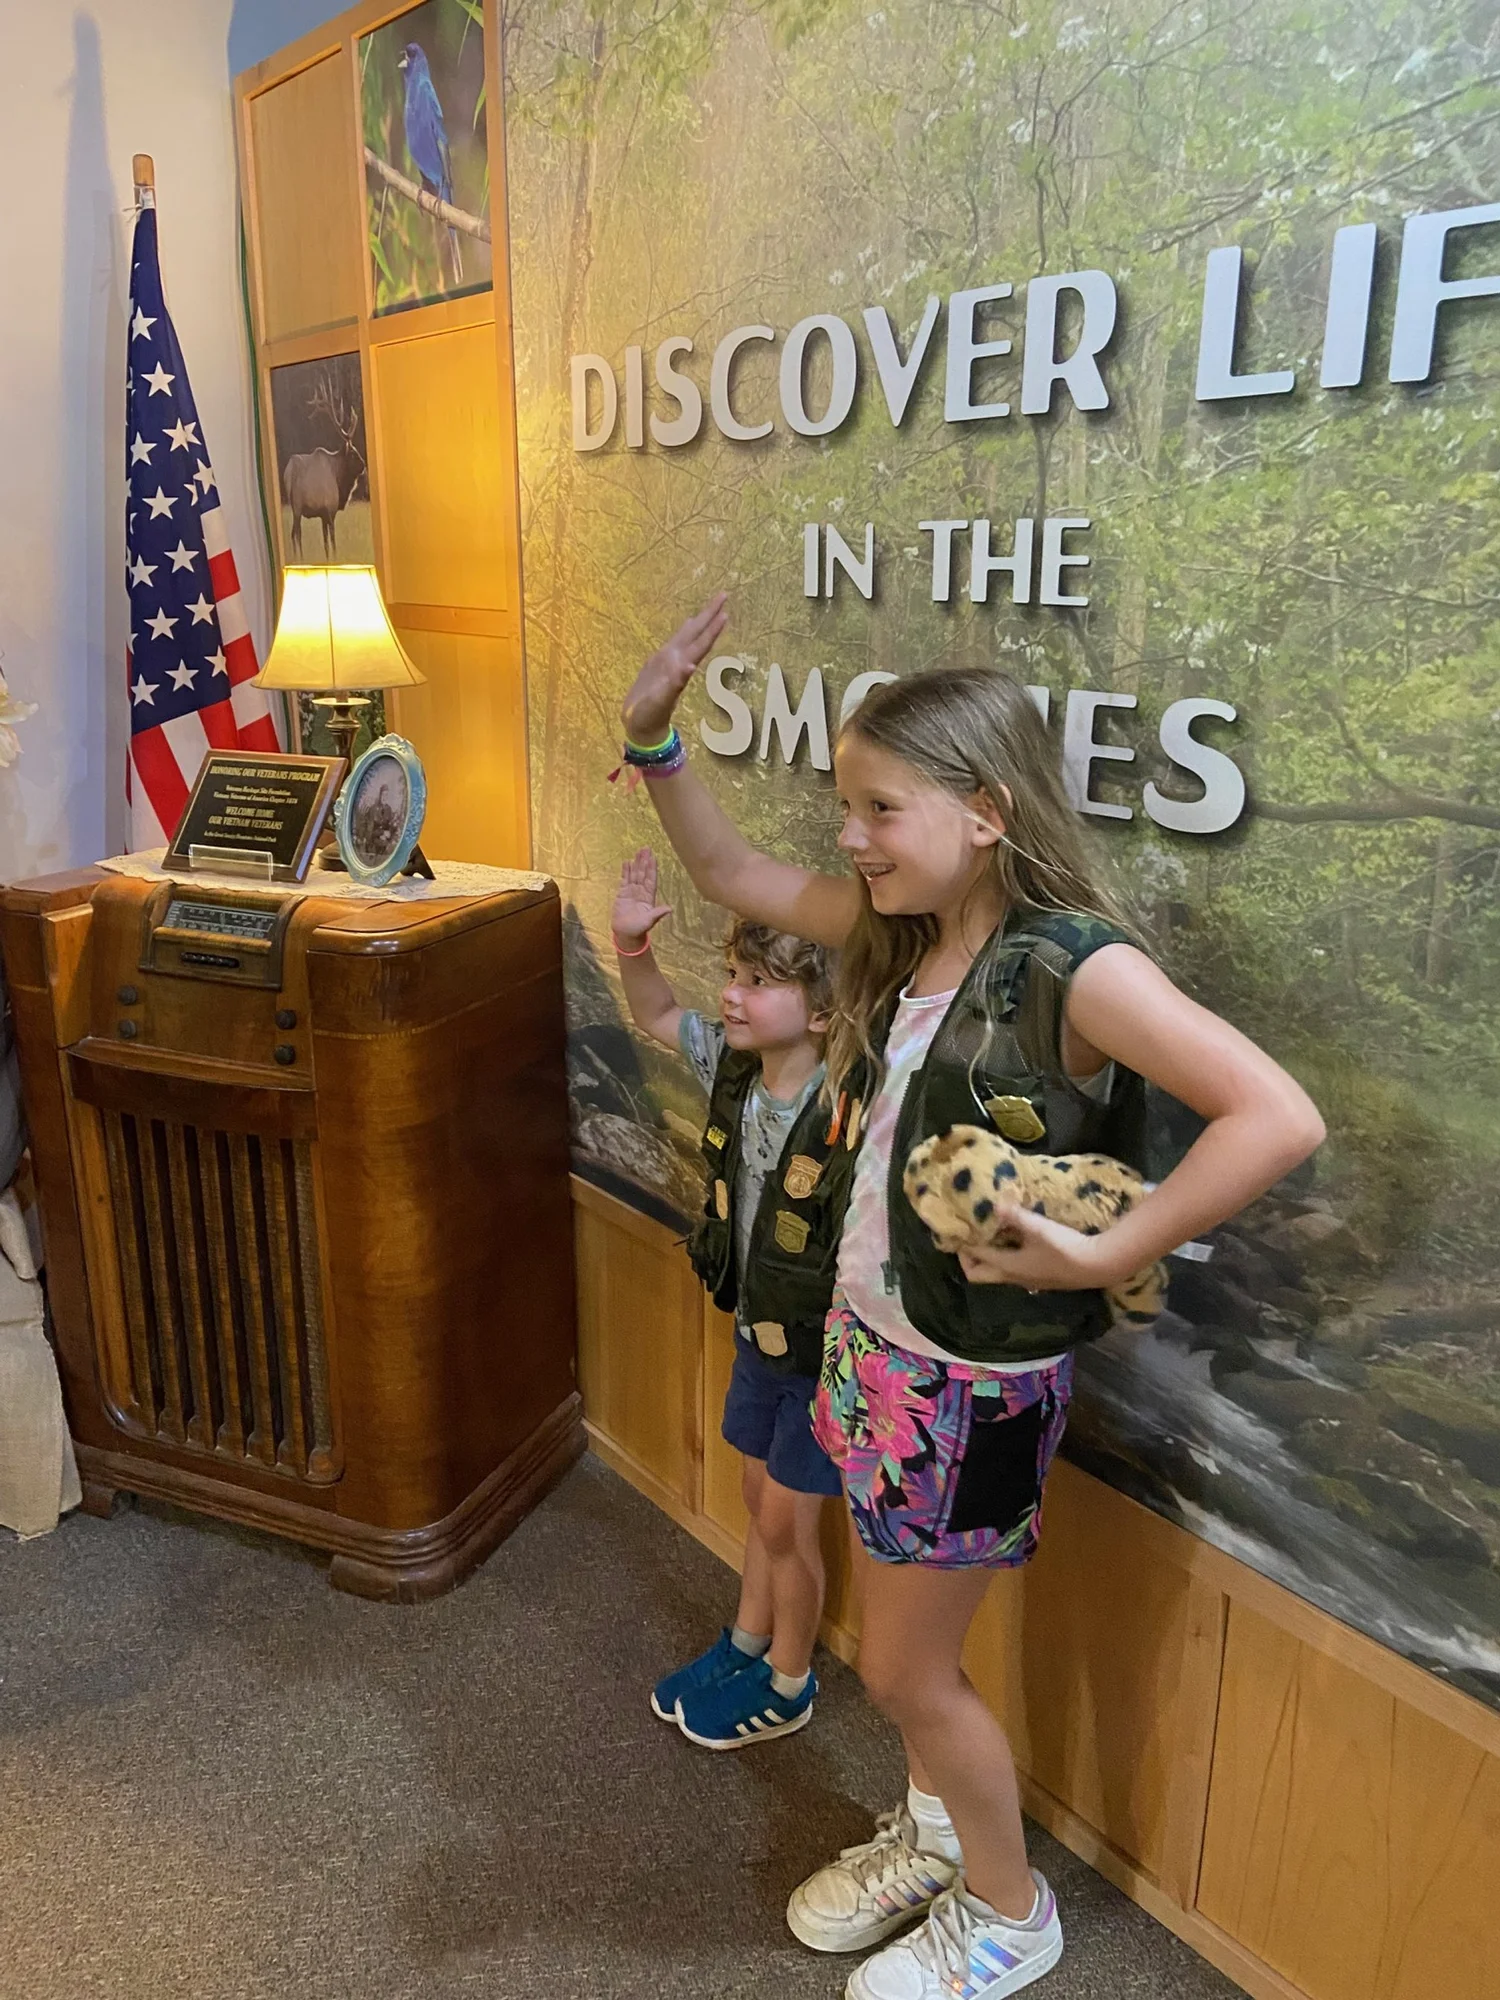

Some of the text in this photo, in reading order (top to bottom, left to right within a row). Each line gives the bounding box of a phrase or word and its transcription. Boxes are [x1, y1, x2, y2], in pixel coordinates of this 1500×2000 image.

[571, 269, 1117, 452] DISCOVER
[804, 518, 1090, 606] IN THE
[701, 655, 1246, 834] SMES
[242, 768, 257, 777] OUR
[257, 769, 289, 780] VETERANS
[288, 771, 321, 782] PROGRAM
[208, 815, 284, 830] OUR VIETNAM VETERANS
[225, 806, 275, 818] WELCOME HOME
